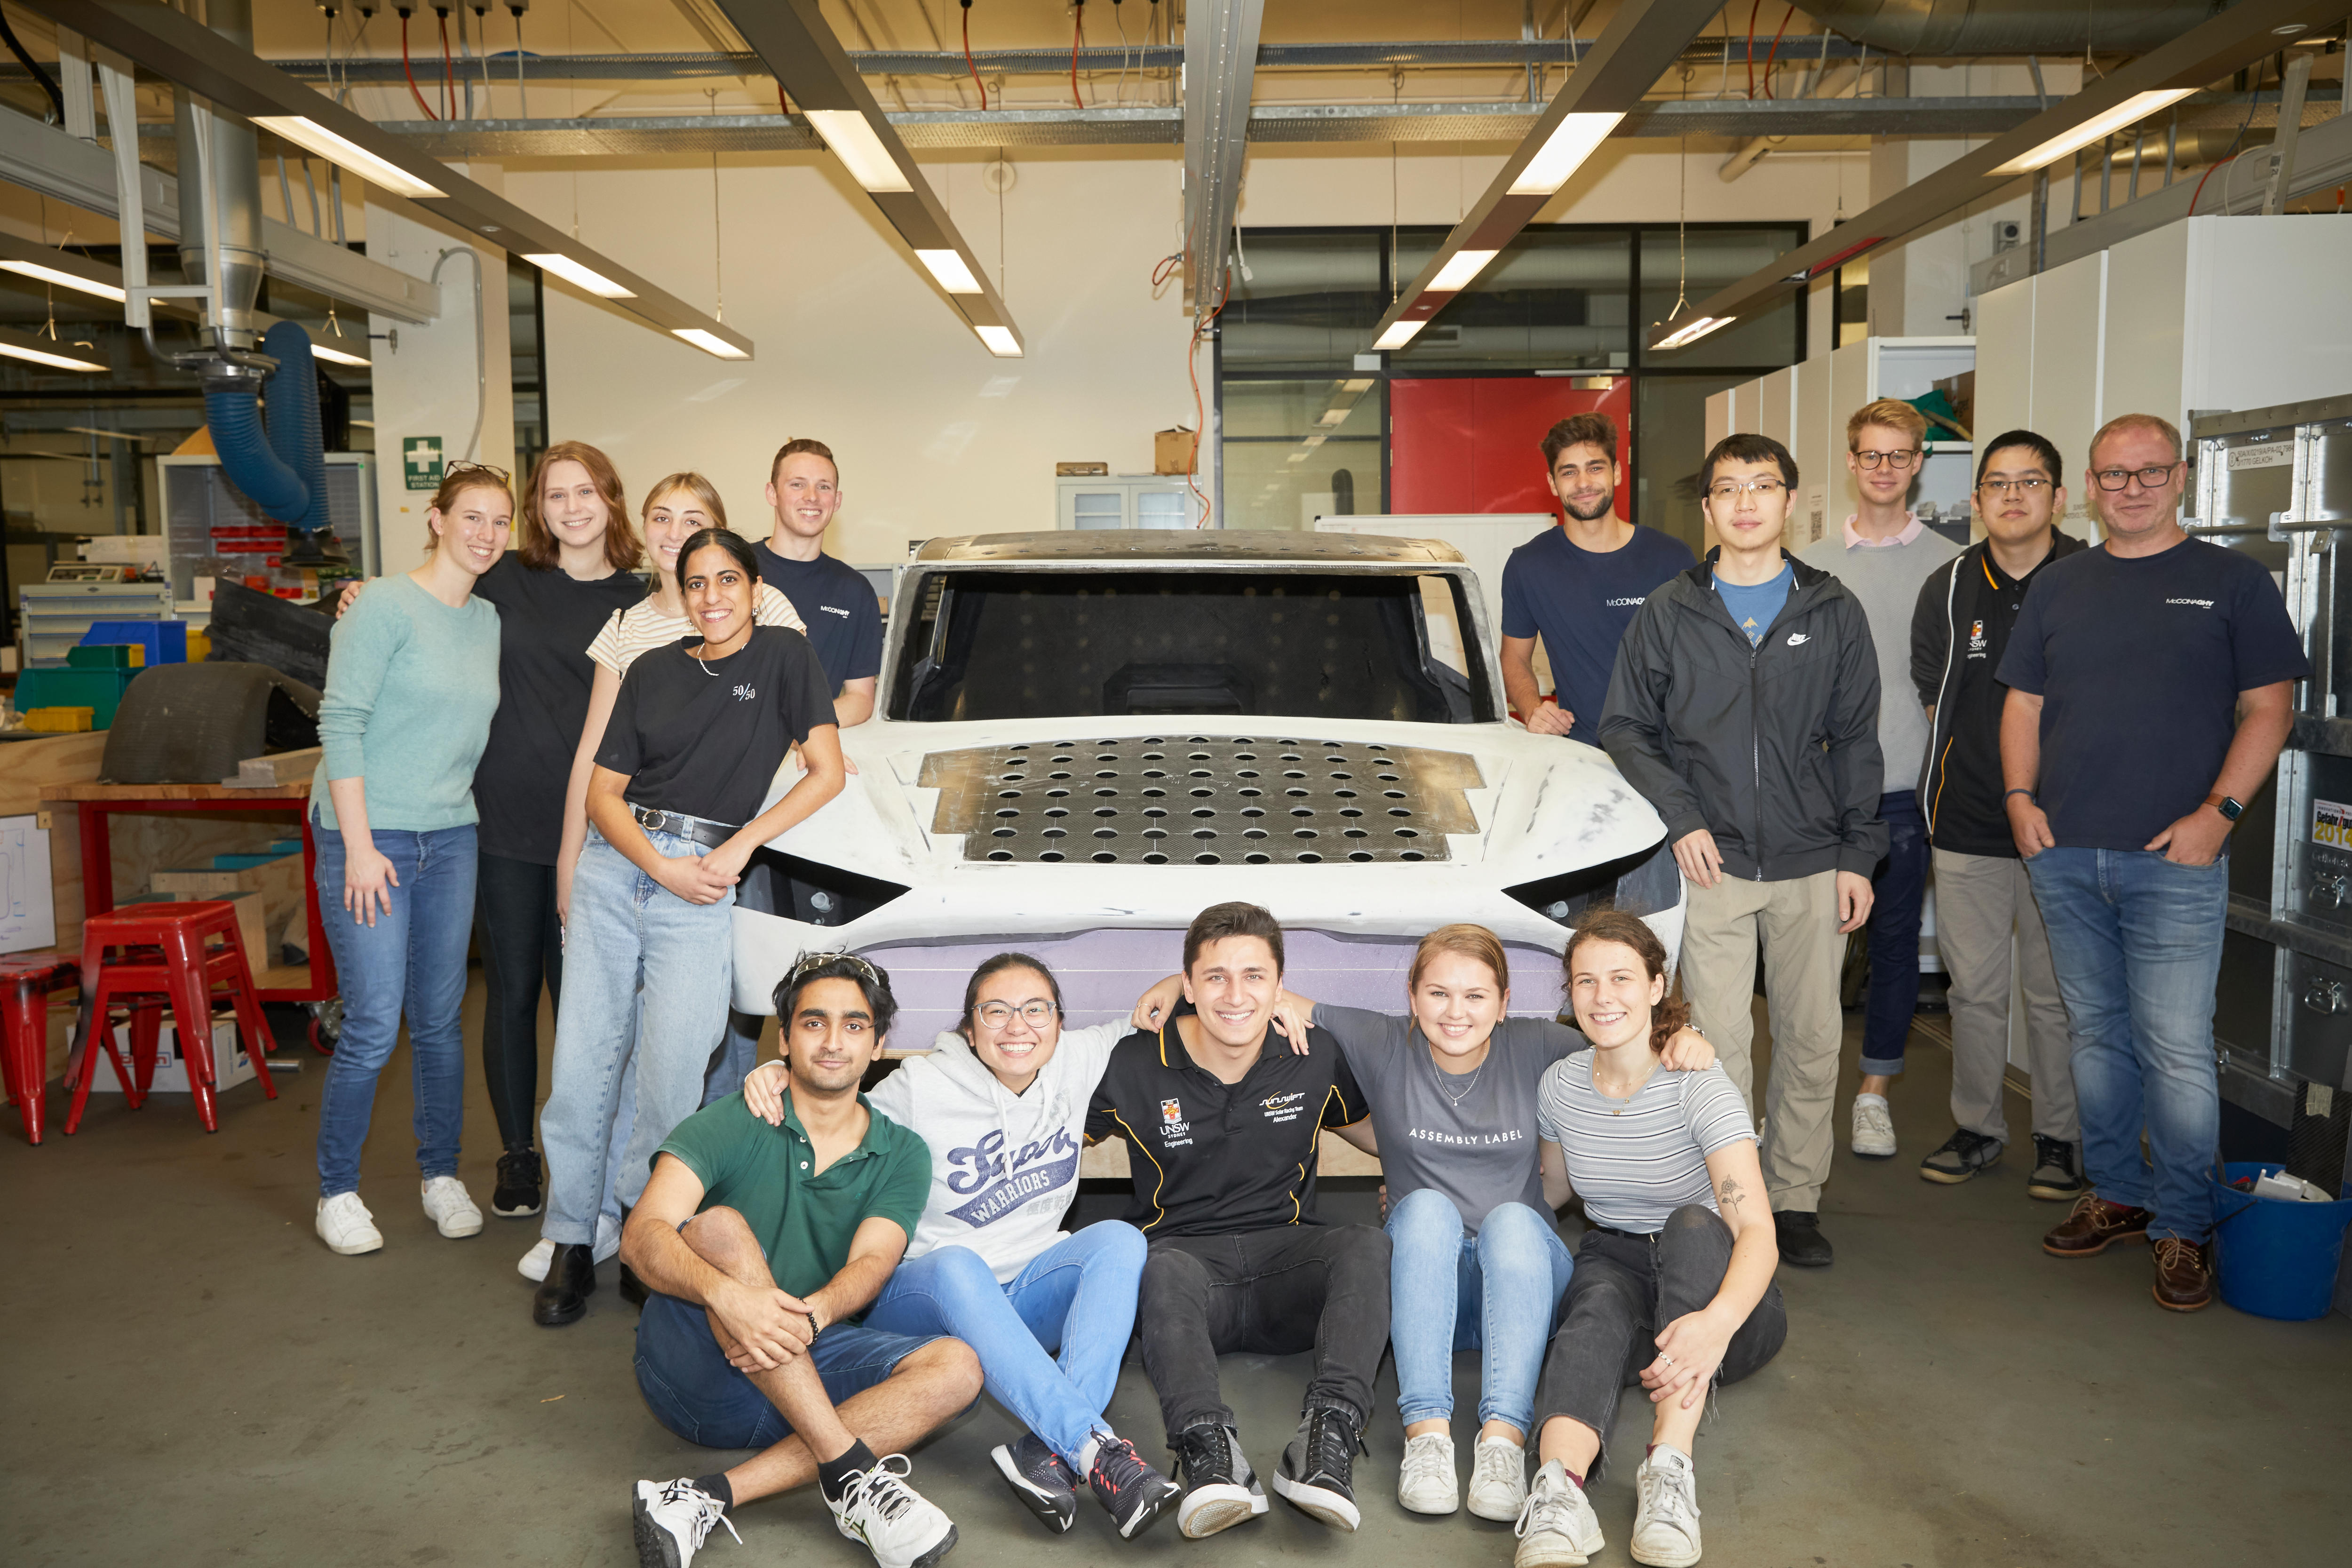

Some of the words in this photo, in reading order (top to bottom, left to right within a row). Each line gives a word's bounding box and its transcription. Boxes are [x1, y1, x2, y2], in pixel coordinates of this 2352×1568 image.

[1606, 597, 1645, 606] McCONAG
[820, 605, 850, 616] McCONGHY
[1791, 633, 1806, 642] NIKE
[732, 683, 755, 701] 50/50
[1273, 1114, 1297, 1123] Alexander
[1160, 1122, 1190, 1135] UNSW
[1409, 1128, 1478, 1145] ASSEMBLY
[1485, 1129, 1523, 1144] LABEL
[1164, 1138, 1193, 1148] Engineering
[970, 1170, 1050, 1223] WARRIORS
